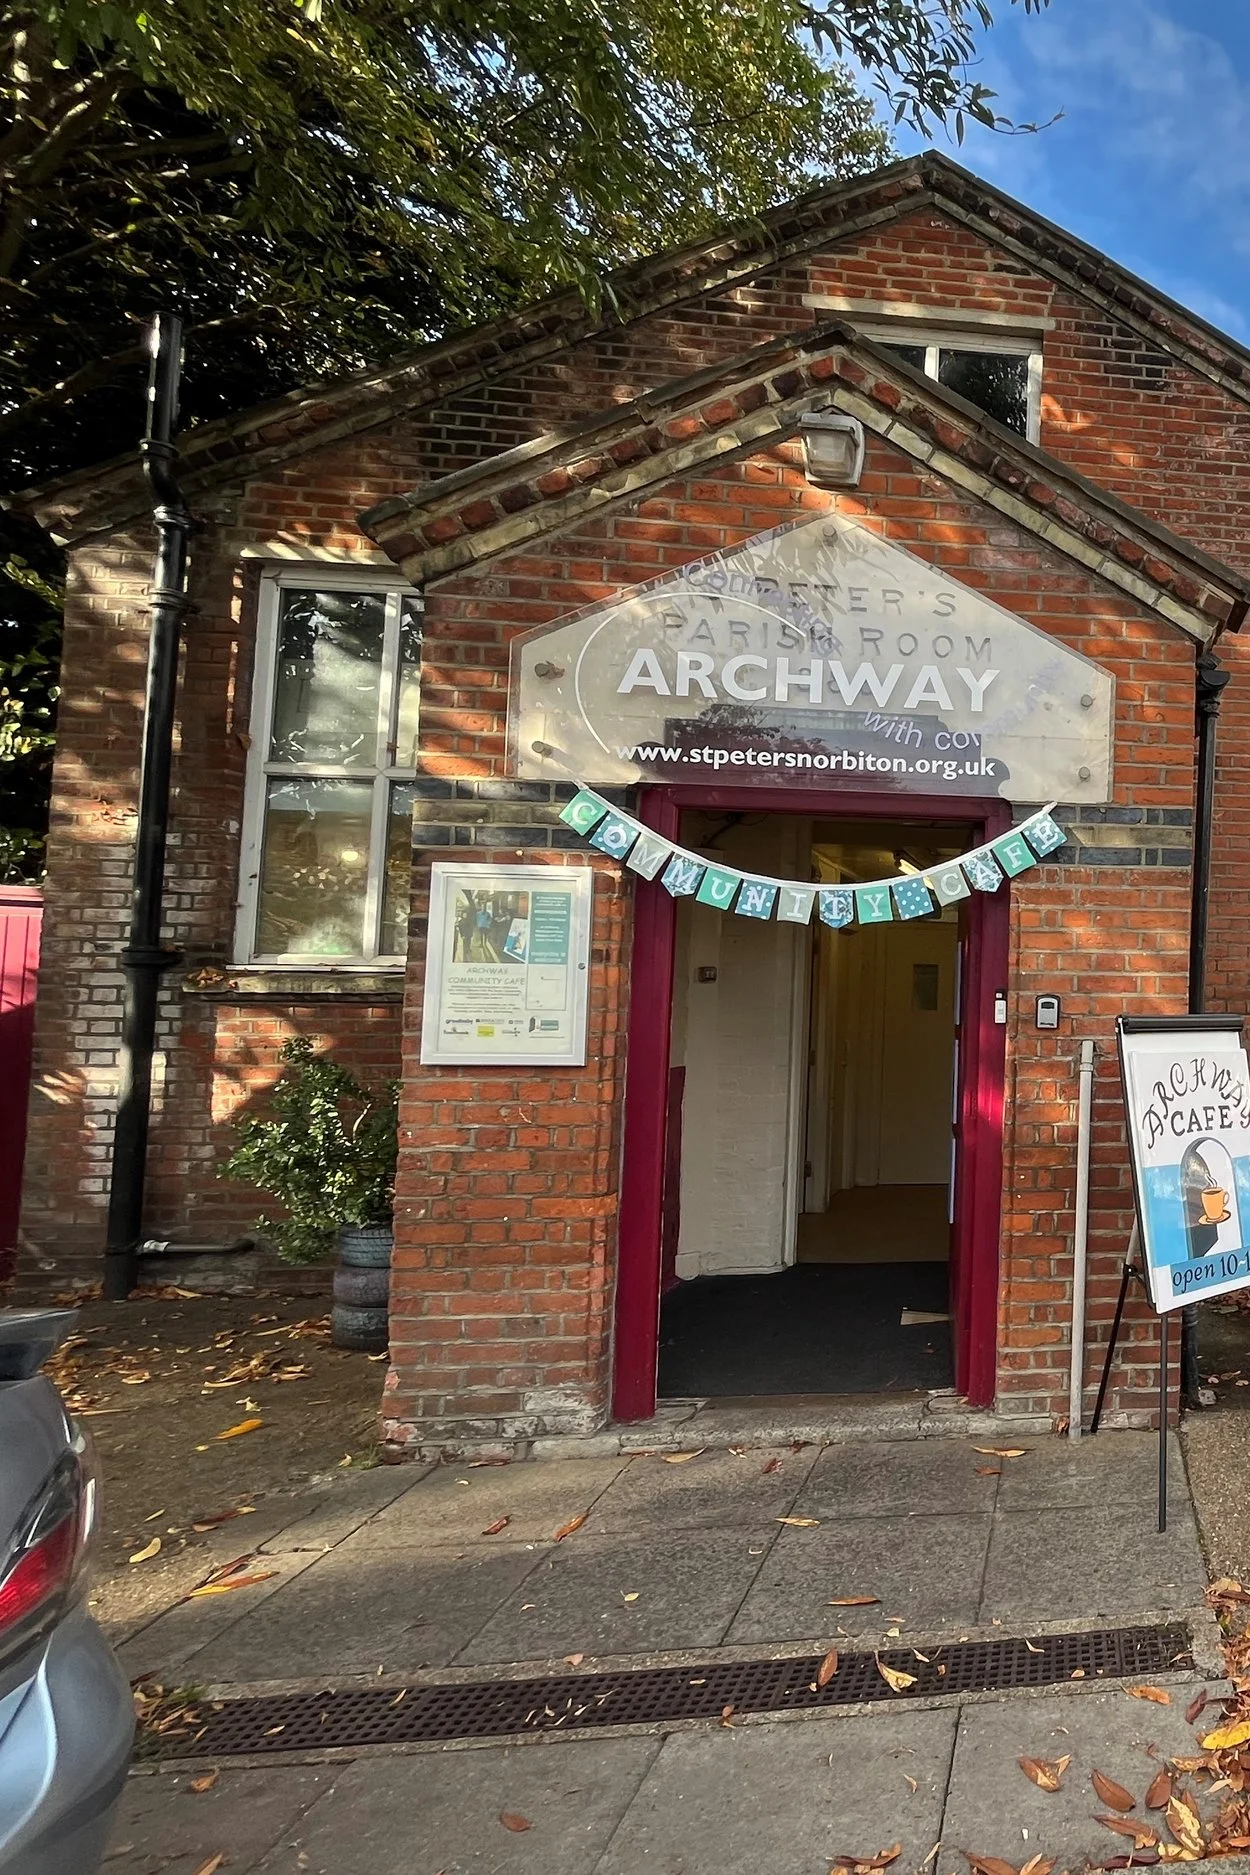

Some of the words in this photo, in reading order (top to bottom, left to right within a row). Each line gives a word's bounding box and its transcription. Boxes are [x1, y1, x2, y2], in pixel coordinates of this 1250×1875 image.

[858, 626, 993, 662] ROOM
[616, 647, 1001, 712] ARCHWAY
[863, 711, 923, 748] with
[614, 744, 997, 781] www.stpetersnorbiton.org.uk
[571, 801, 888, 919] COMMUNITY
[940, 819, 1060, 897] CAFE
[447, 976, 502, 985] COMMUNITY
[503, 977, 526, 986] CAFE
[466, 967, 509, 975] ARCHWAY
[1170, 1105, 1234, 1137] CAFE
[1172, 1263, 1215, 1294] open
